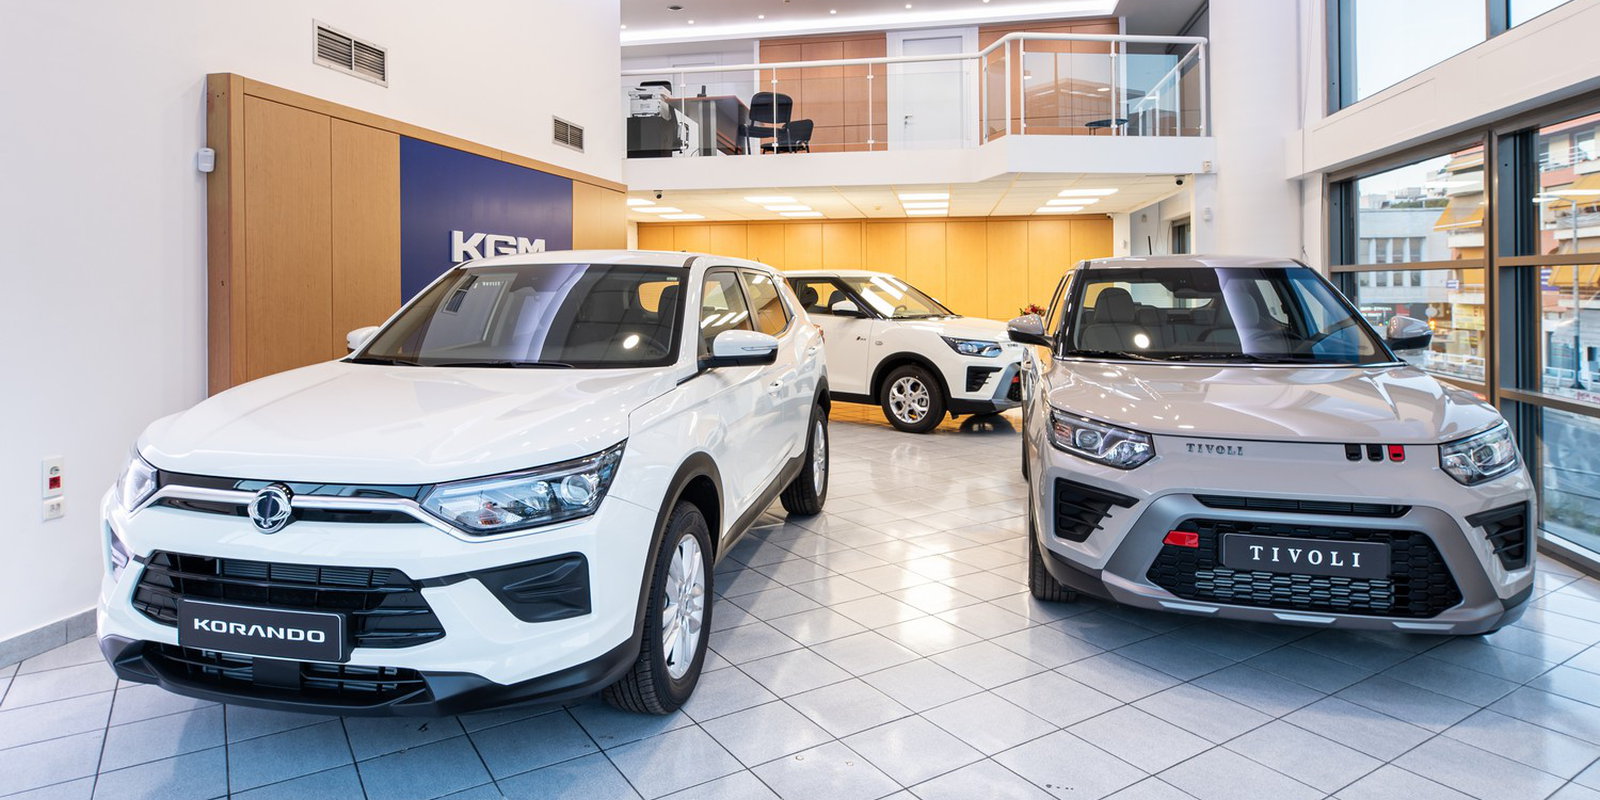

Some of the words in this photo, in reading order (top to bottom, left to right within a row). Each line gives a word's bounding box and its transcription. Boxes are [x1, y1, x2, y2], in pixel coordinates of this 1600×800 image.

[451, 230, 545, 262] KGM
[1186, 443, 1243, 456] TIVOLI
[1249, 545, 1360, 567] TIVOLI
[193, 618, 325, 643] KORANDO
